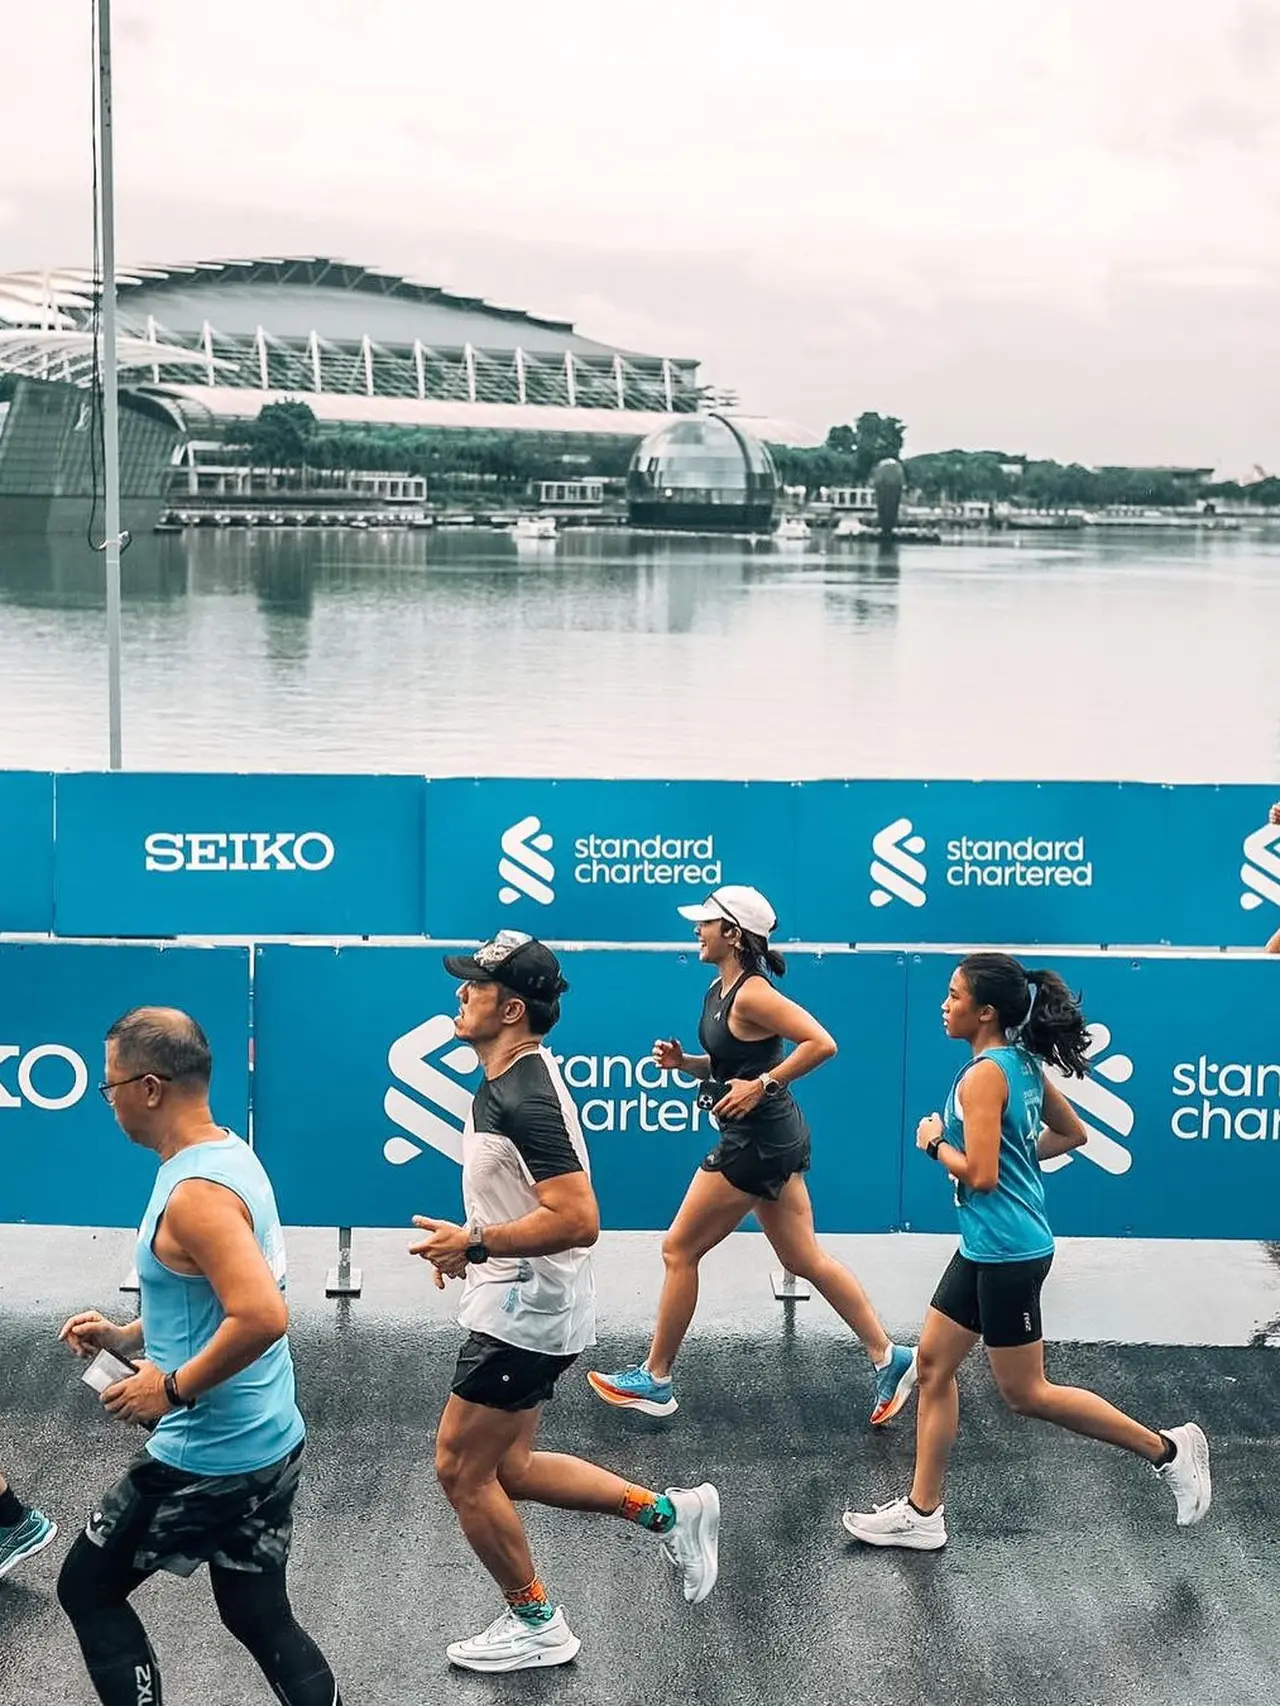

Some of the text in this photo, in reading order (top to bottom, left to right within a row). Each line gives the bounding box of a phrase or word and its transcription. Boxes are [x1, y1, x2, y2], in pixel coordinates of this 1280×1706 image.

[144, 832, 335, 872] SEIKO
[574, 834, 713, 859] standard
[946, 836, 1084, 861] standard
[574, 859, 722, 884] chartered
[946, 861, 1093, 887] chartered
